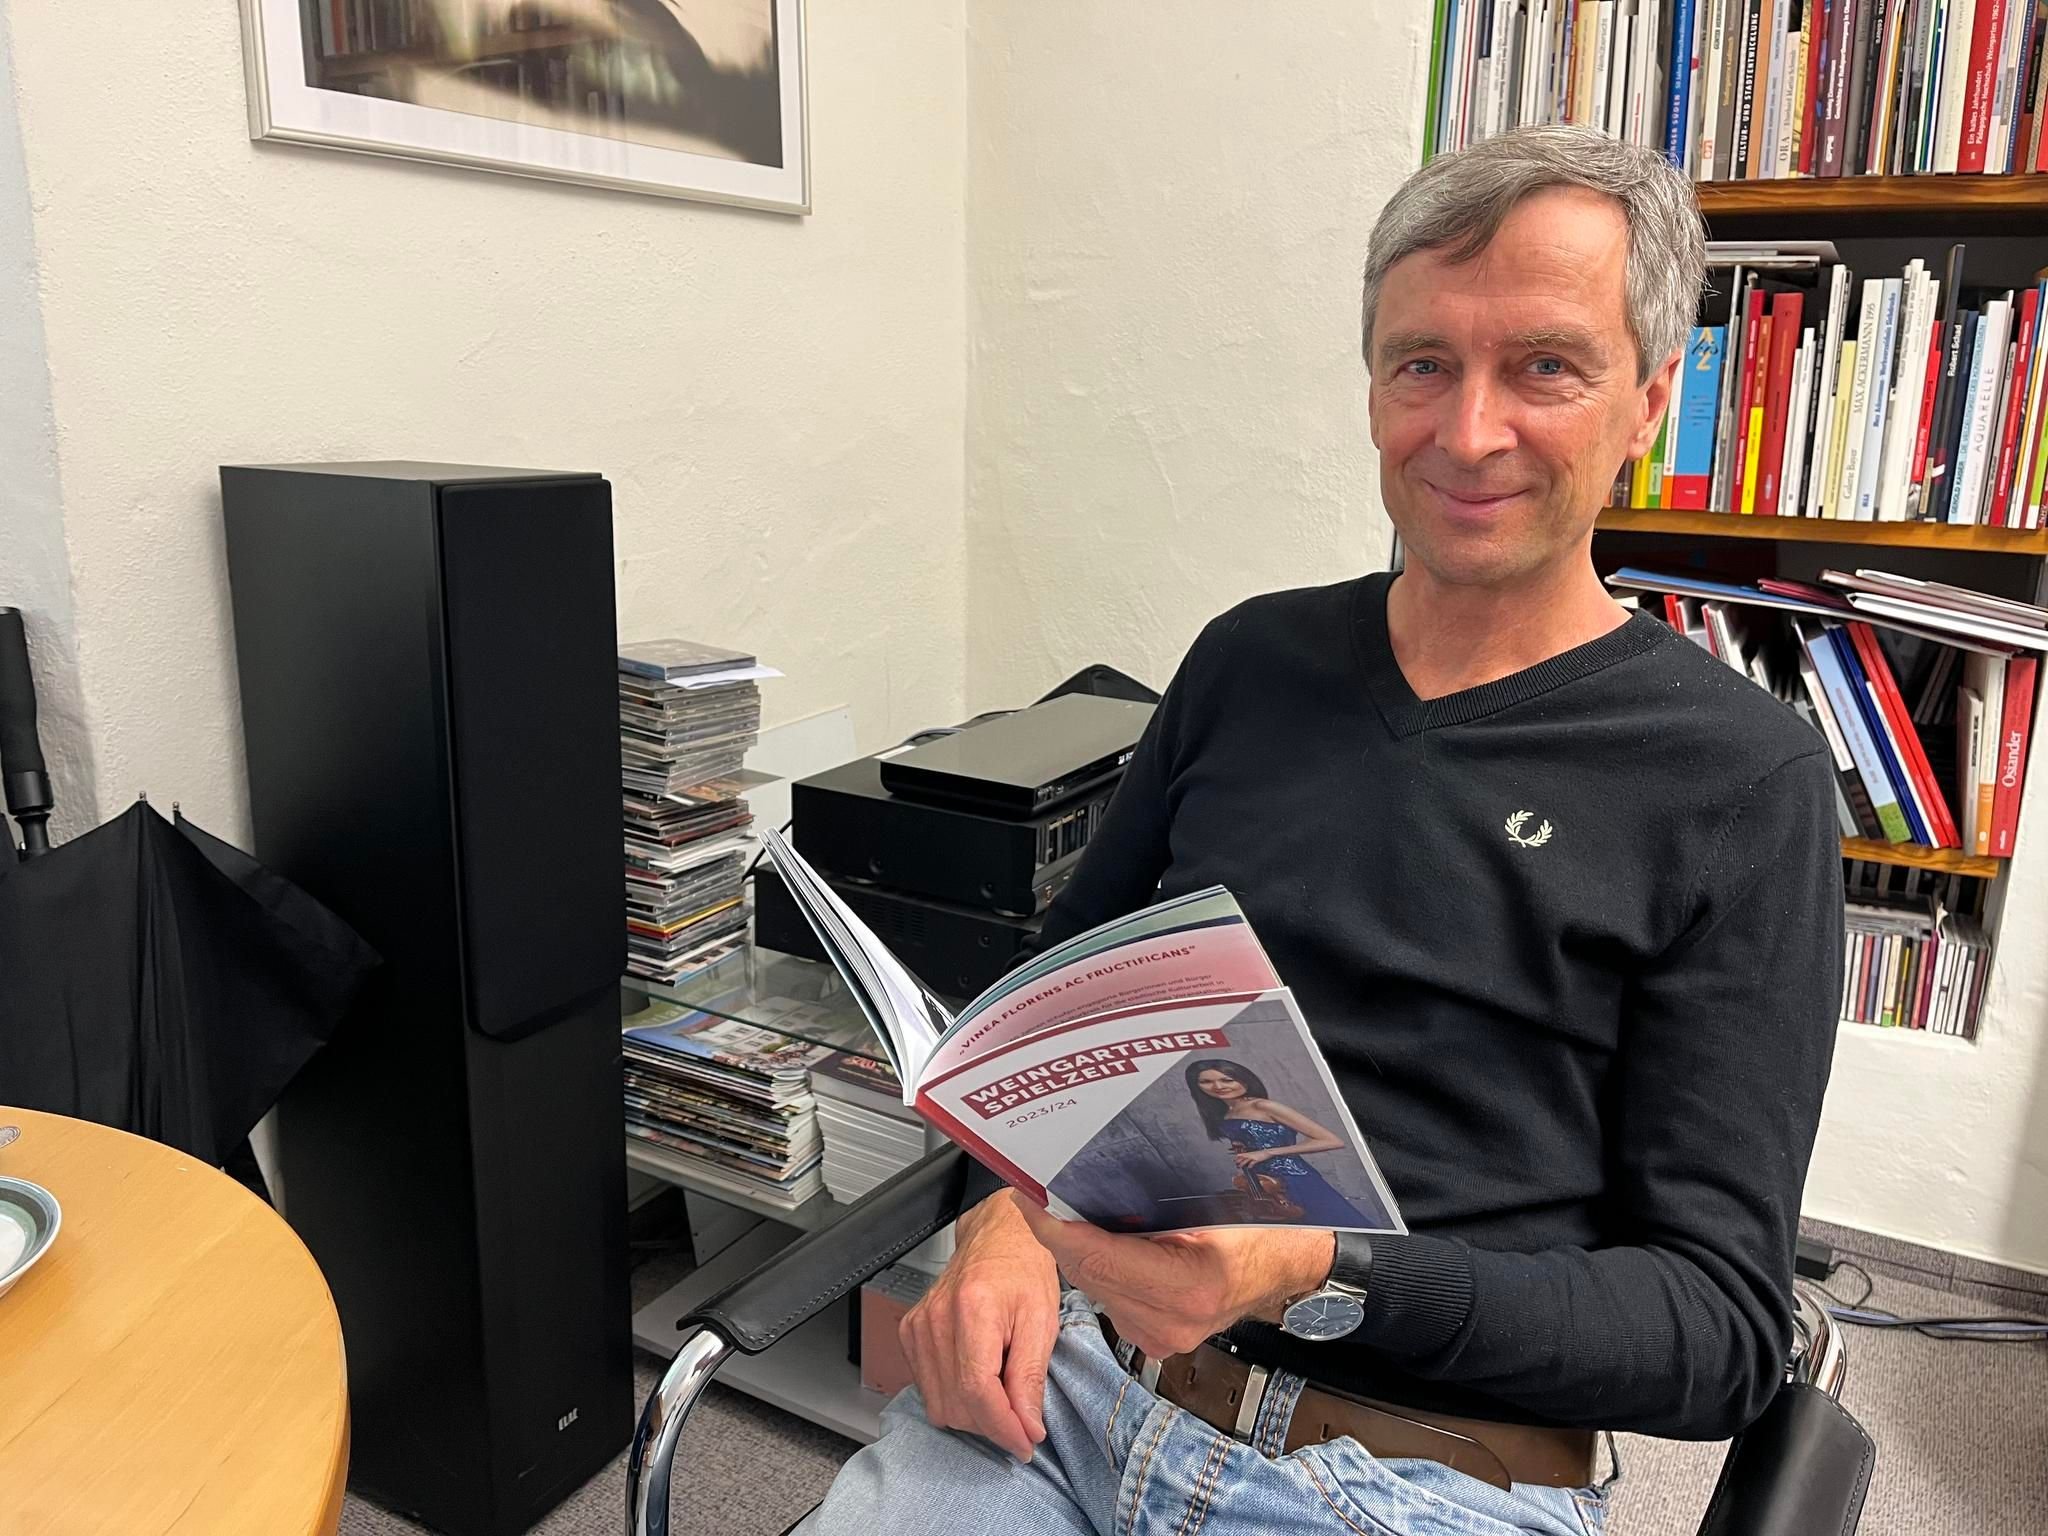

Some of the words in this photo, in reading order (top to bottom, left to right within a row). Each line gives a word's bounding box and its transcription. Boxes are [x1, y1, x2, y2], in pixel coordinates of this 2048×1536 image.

[1986, 22, 1997, 60] Weingarten
[1738, 126, 1748, 162] KULTUR-
[1744, 13, 1758, 100] STADTENTWICKLUNG
[1972, 70, 1983, 109] Jahrhundert
[1982, 62, 1992, 99] Hochschule
[1672, 94, 1680, 124] SÜDEN
[1826, 99, 1834, 120] Ludwig
[1969, 111, 1978, 132] halbes
[1976, 101, 1988, 144] Pädagogische
[1779, 136, 1789, 161] ORA
[1967, 133, 1975, 144] Ein
[1866, 303, 1876, 320] 1995
[1951, 325, 1961, 348] Schad
[1857, 322, 1874, 388] ACKERMANN
[1947, 350, 1959, 376] Robert
[1853, 392, 1865, 414] MAX
[1974, 368, 1994, 452] AQUARELLE
[1843, 473, 1855, 499] Galerie
[2002, 731, 2022, 787] Osiander
[1168, 977, 1184, 985] und
[1185, 974, 1212, 982] Bürger
[1001, 985, 1062, 1020] FLORENS
[1065, 976, 1084, 989] AC
[970, 1031, 1217, 1104] WEINGARTENER
[983, 1060, 1130, 1114] SPIELZEIT
[1006, 1097, 1078, 1128] 2023/24
